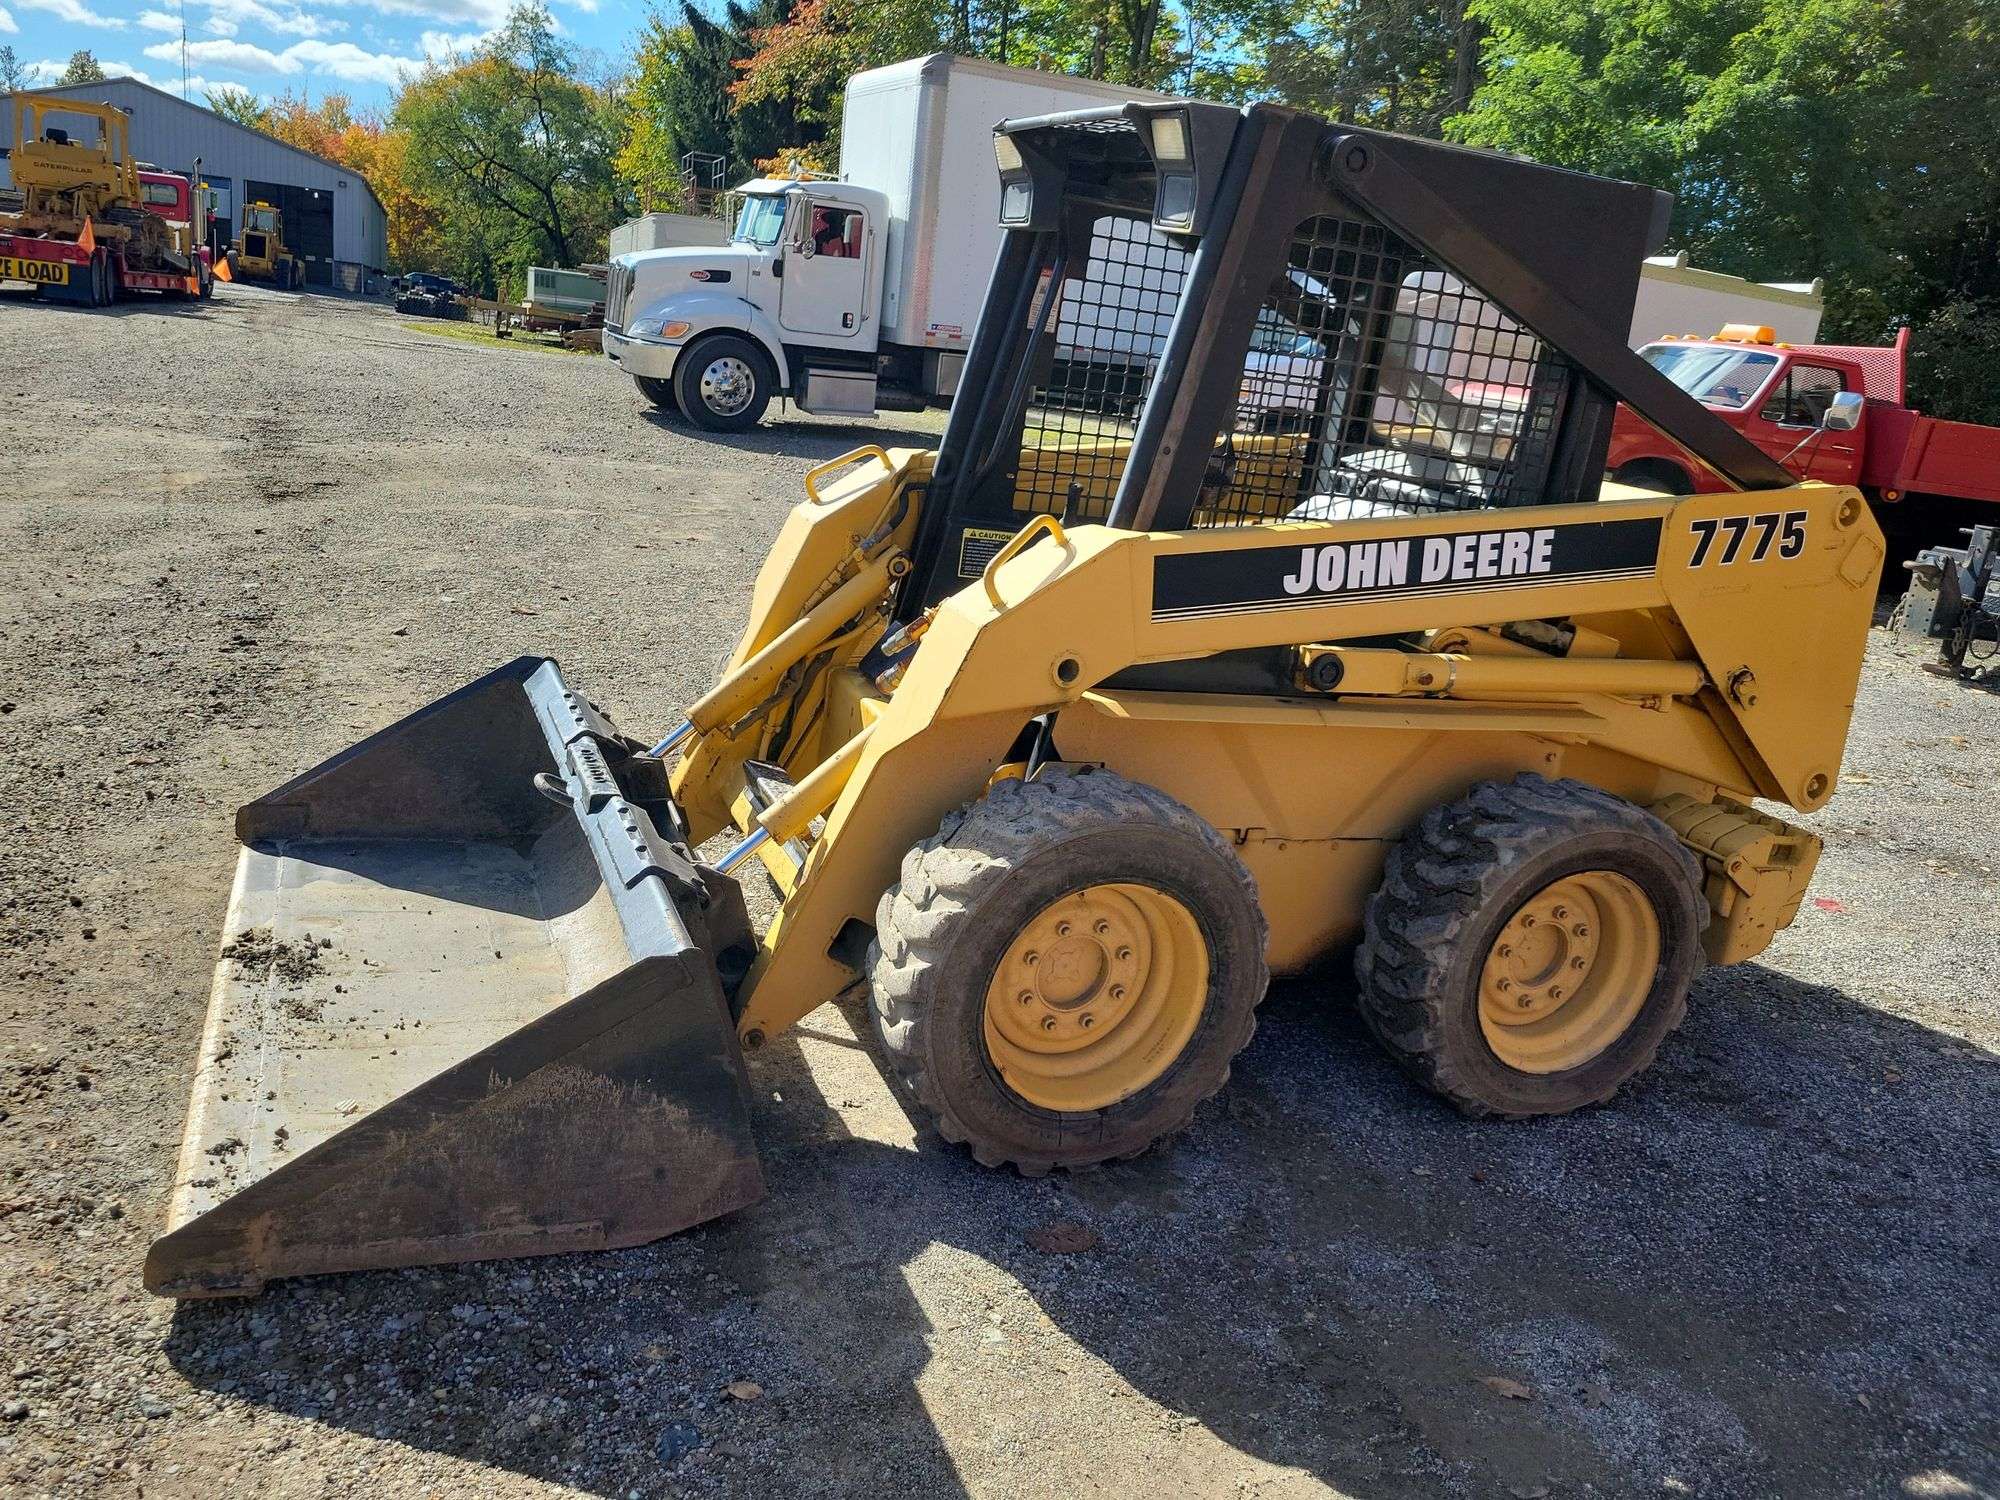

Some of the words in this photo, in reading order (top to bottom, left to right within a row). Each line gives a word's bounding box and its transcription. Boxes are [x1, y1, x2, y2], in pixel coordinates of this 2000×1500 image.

[18, 260, 63, 282] LOAD
[978, 531, 1012, 540] CAUTION
[1687, 510, 1808, 568] 7775
[1282, 541, 1409, 594] JOHN
[1420, 529, 1555, 583] DEERE
